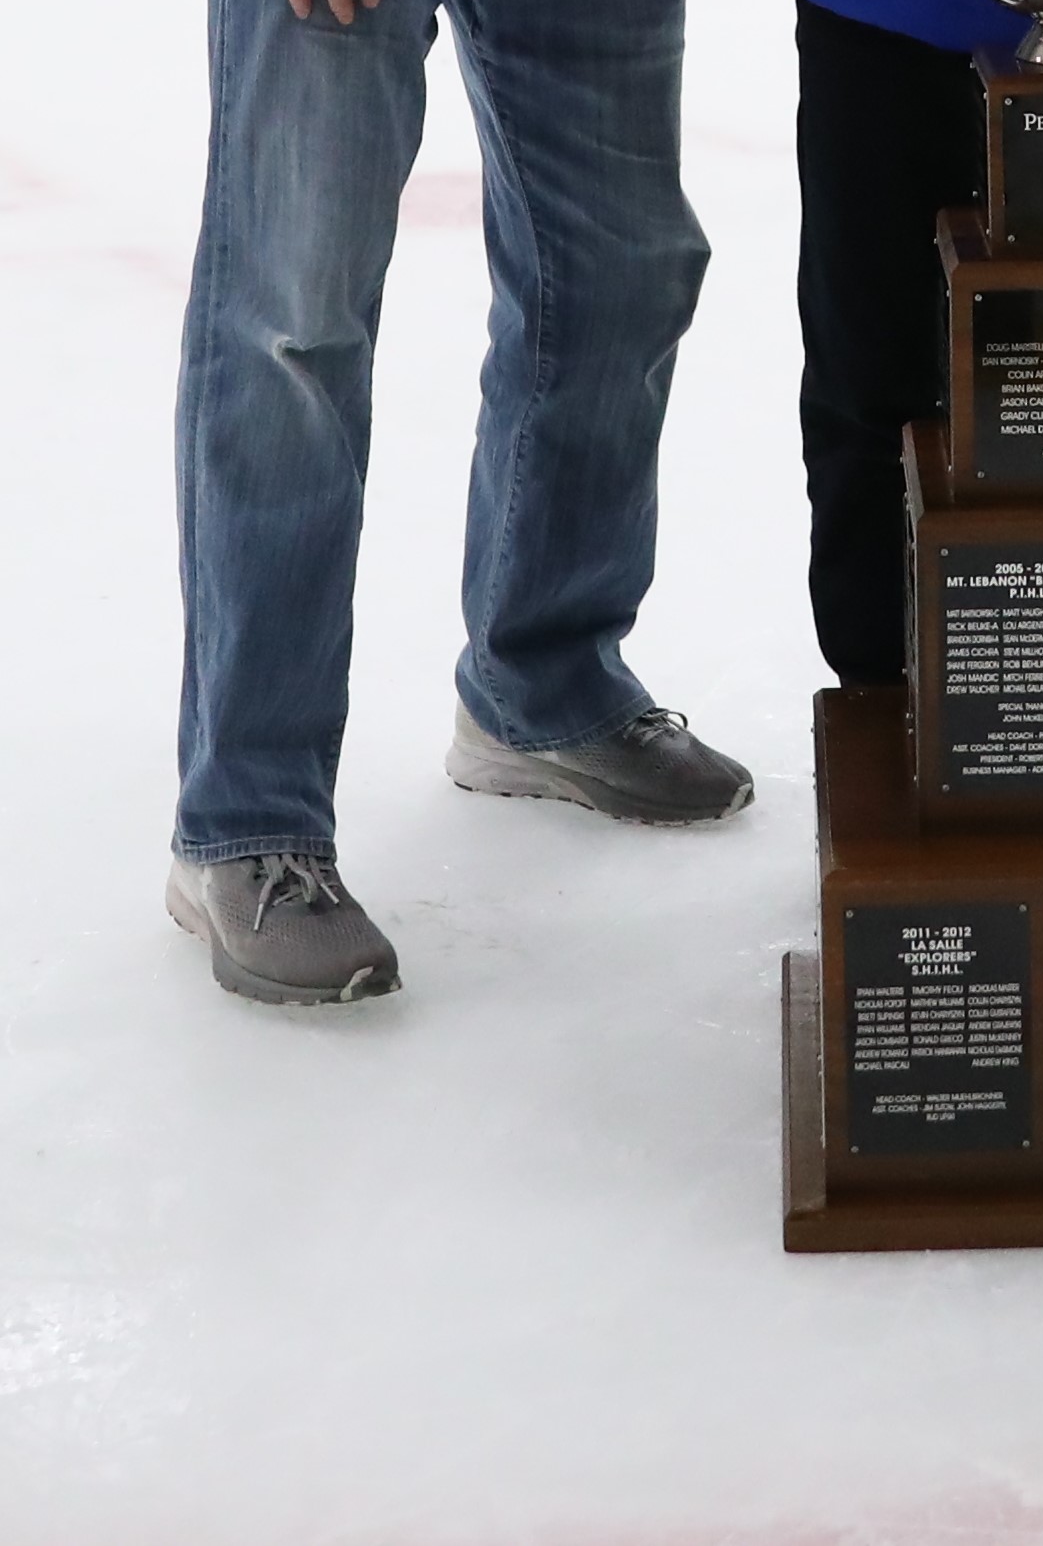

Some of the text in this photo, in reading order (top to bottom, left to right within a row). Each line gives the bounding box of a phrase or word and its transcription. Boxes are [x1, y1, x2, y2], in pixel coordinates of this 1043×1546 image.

[1000, 398, 1028, 406] JASON
[1000, 412, 1030, 420] GRADY
[1000, 426, 1036, 434] MICHAEL
[995, 564, 1024, 574] 2005
[947, 577, 967, 587] MT.
[970, 576, 1027, 586] LEBANON
[902, 928, 930, 938] 2011
[942, 927, 972, 937] 2012
[911, 940, 963, 950] LA SALLE
[898, 952, 977, 962] "EXPLORERS"
[911, 965, 964, 975] S.H.I.H.L.
